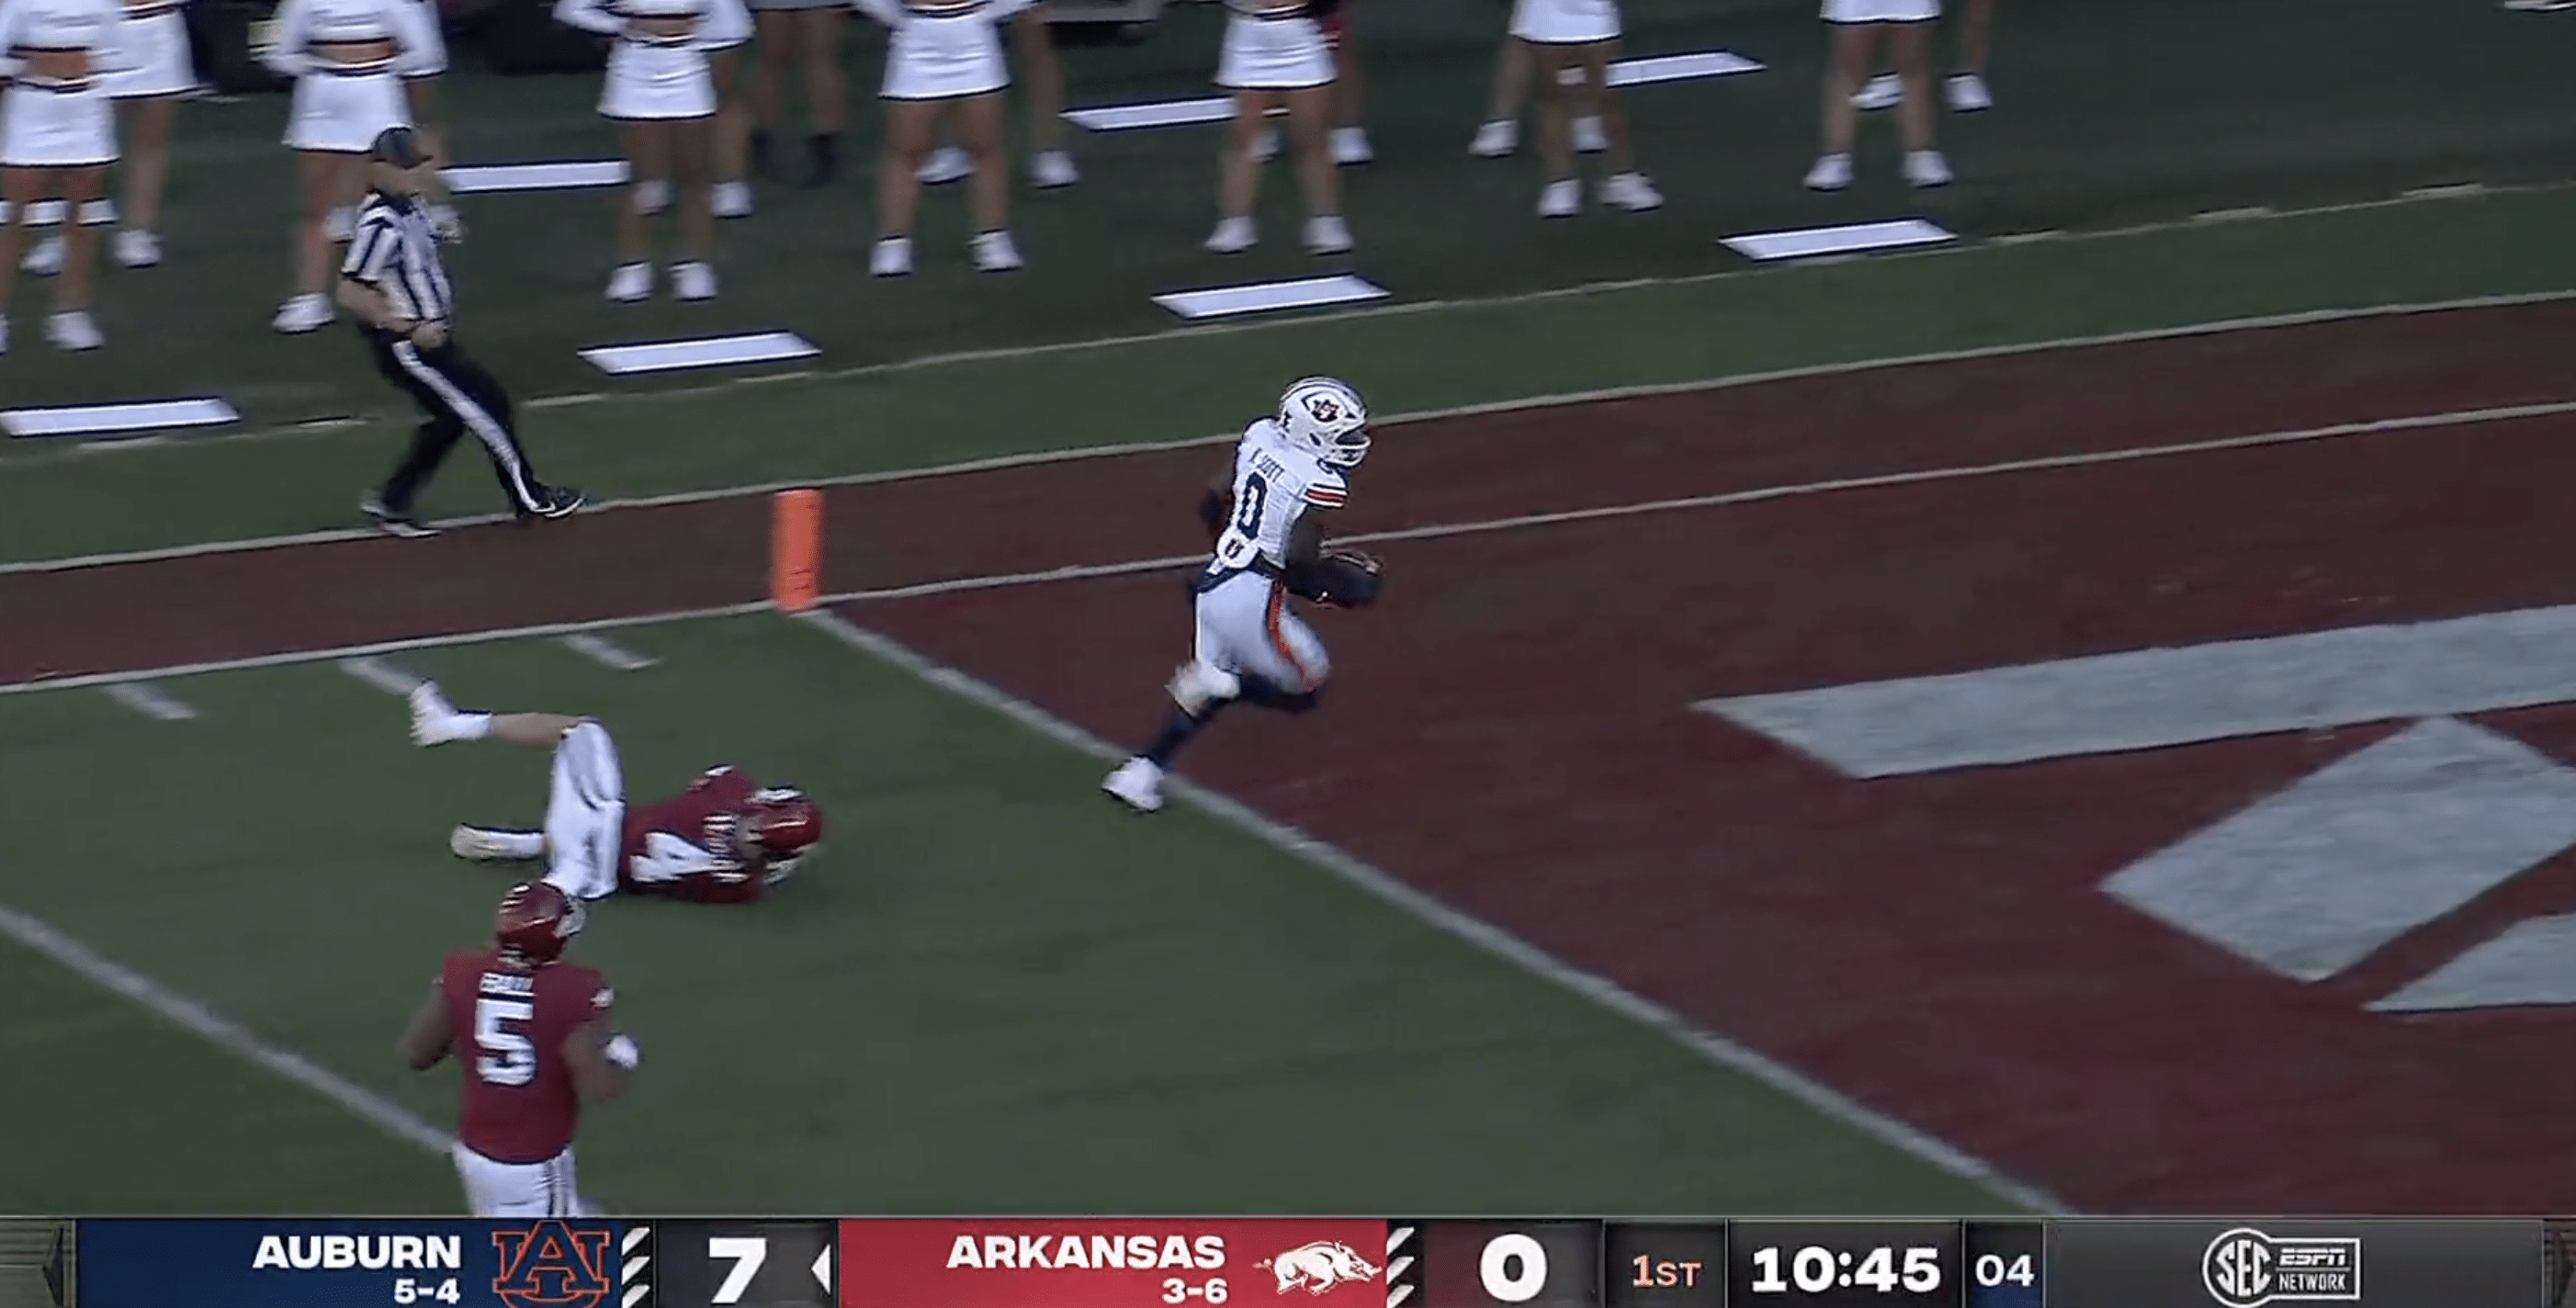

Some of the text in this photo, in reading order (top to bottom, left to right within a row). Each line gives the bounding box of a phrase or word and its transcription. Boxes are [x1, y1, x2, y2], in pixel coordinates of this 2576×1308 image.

[1237, 471, 1268, 540] 0
[629, 832, 726, 883] 4
[475, 998, 536, 1087] 5
